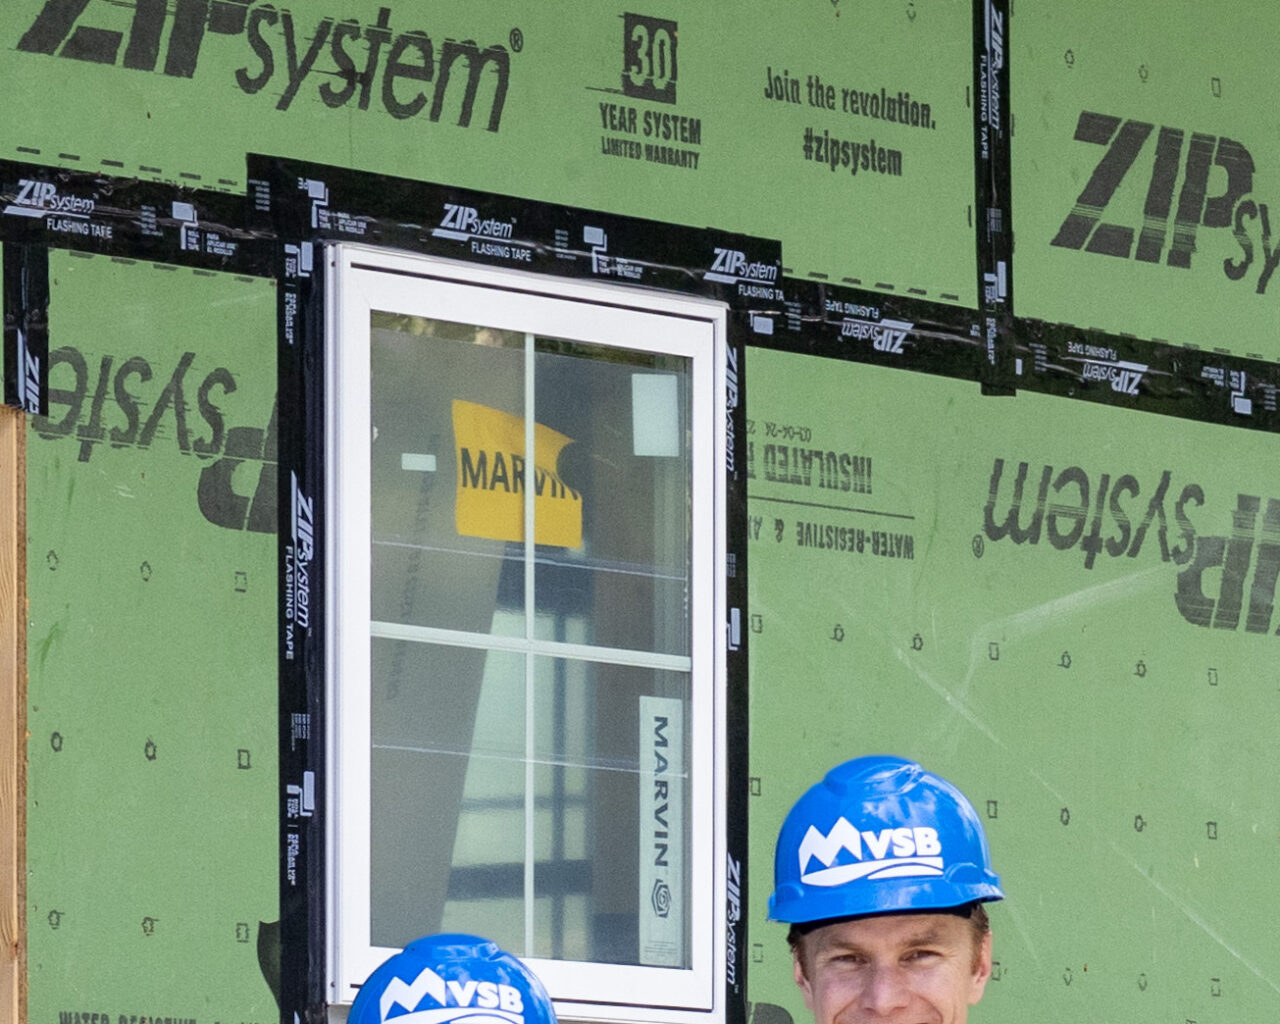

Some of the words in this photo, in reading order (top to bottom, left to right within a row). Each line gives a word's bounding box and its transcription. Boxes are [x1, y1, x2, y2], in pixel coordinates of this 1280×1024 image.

[629, 23, 673, 92] 30
[764, 66, 802, 104] Join
[807, 74, 836, 110] the
[841, 84, 937, 131] revolution.
[980, 54, 988, 122] FLASHING
[599, 102, 638, 135] YEAR
[643, 110, 702, 145] SYSTEM
[981, 126, 989, 159] TAPE
[601, 136, 643, 161] LIMITED
[645, 144, 700, 170] WARRANTY
[803, 127, 903, 177] #zipsystem
[1050, 110, 1280, 294] ZIPsy
[47, 218, 89, 237] FLASHING
[471, 240, 510, 259] FLASHING
[512, 246, 532, 262] TAPE
[738, 283, 774, 300] FLASHING
[845, 302, 879, 318] FLASHING
[763, 442, 873, 495] INSULATED
[796, 518, 915, 561] WATER-RESISTIVE
[286, 546, 294, 619] FLASHING
[286, 623, 294, 660] TAPE
[654, 715, 669, 868] MARVIN
